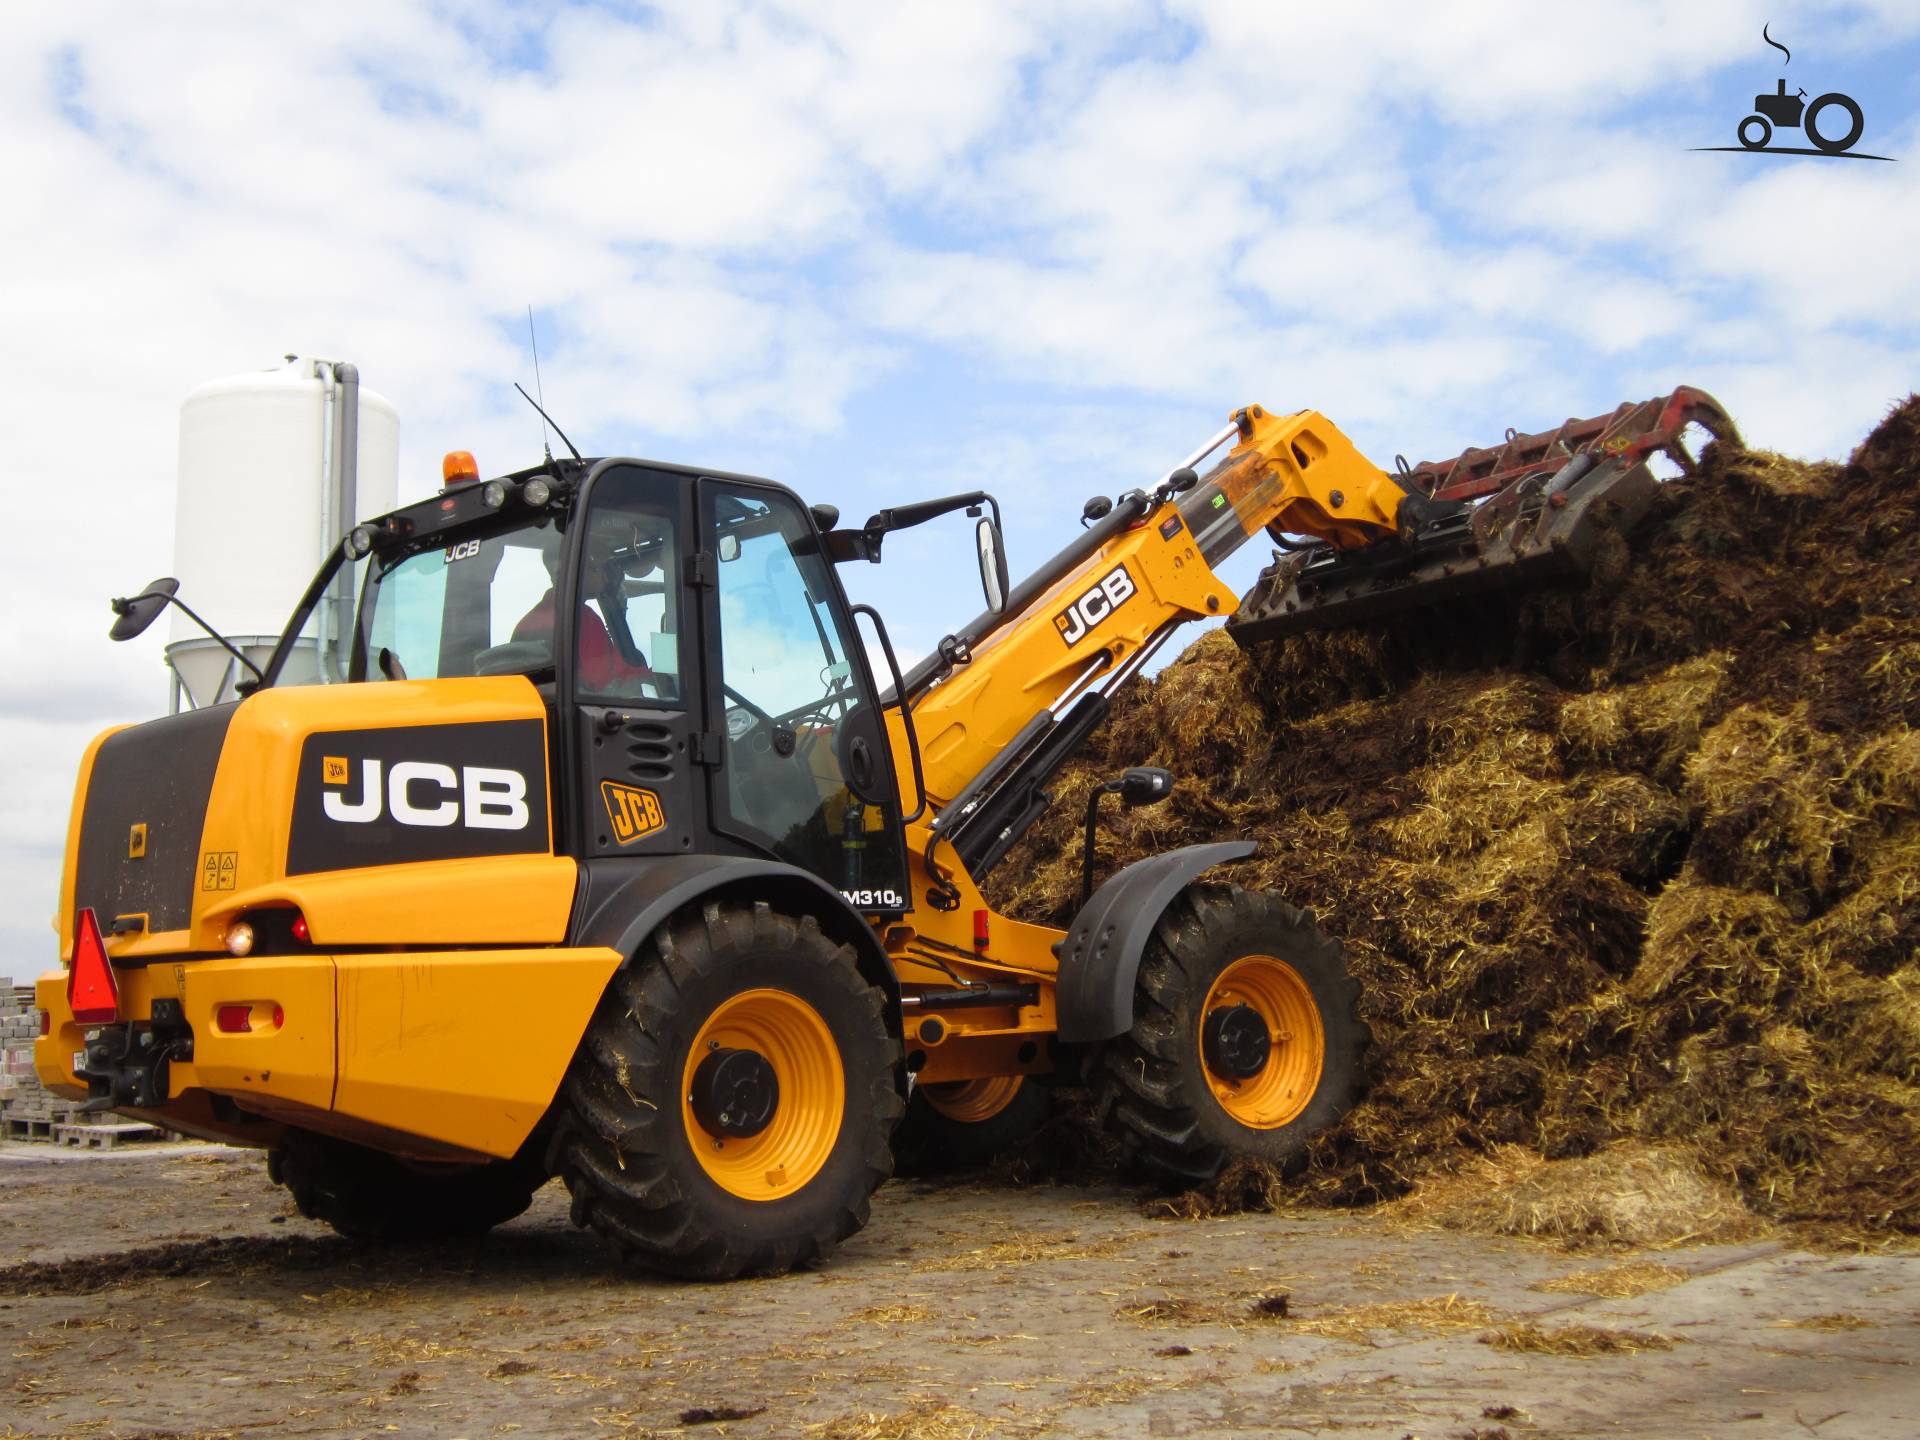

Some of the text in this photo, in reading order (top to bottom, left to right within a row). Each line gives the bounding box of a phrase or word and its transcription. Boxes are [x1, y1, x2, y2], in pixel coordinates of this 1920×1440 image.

[445, 539, 481, 563] JCB
[1063, 568, 1134, 644] JCB
[323, 759, 529, 830] JCB
[612, 789, 660, 837] JCB
